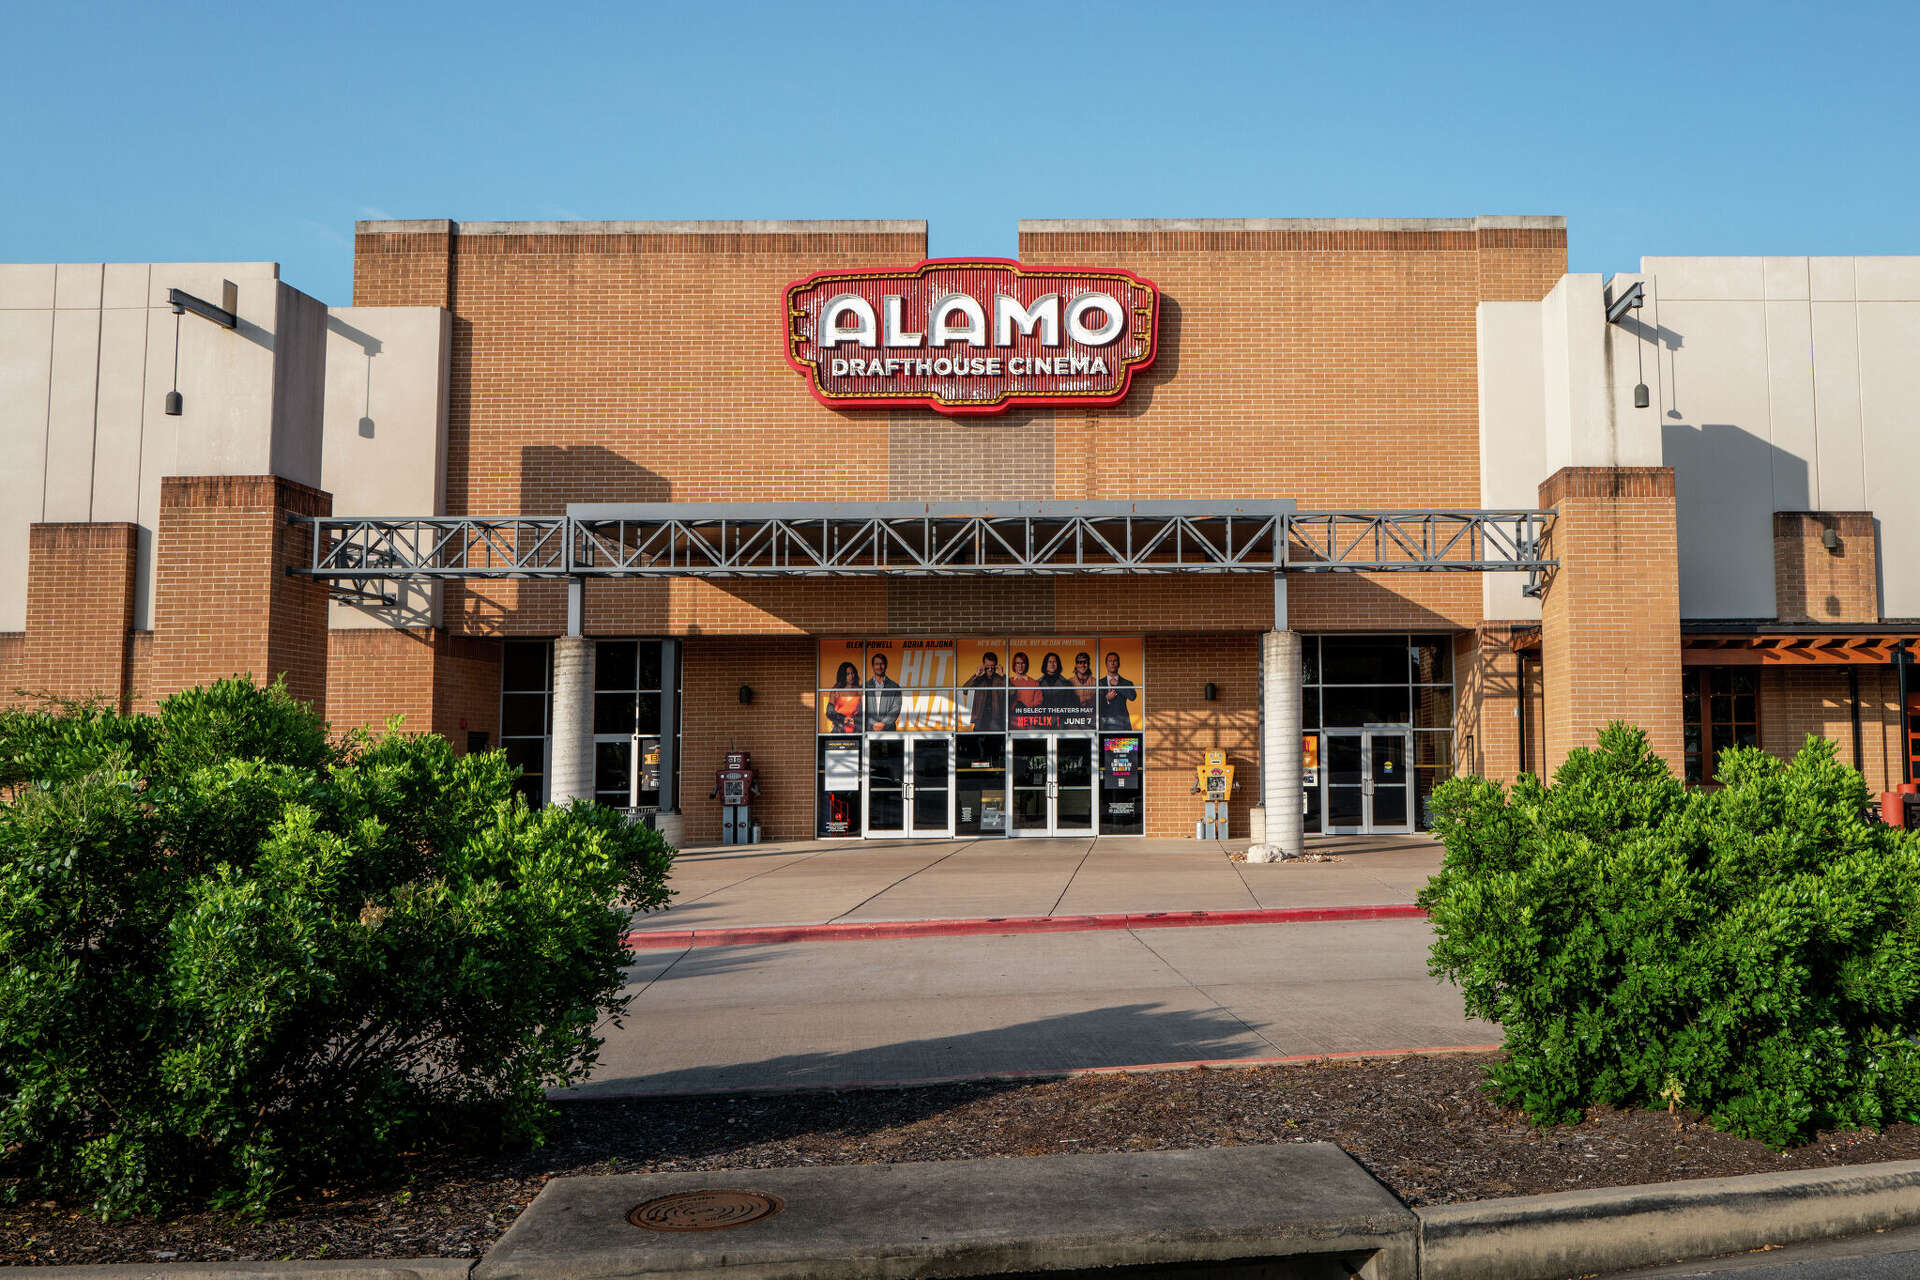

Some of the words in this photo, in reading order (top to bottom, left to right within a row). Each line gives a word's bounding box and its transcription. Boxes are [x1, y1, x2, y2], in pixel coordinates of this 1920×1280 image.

[818, 292, 1124, 348] ALAMO
[831, 356, 1001, 377] DRAFTHOUSE
[1008, 356, 1109, 376] CINEMA
[846, 640, 863, 649] GLEN
[866, 640, 893, 649] POWELL
[902, 640, 923, 649] ADRIA
[925, 640, 953, 649] ARJONA
[899, 650, 953, 687] HIT
[897, 689, 975, 728] MAN
[1017, 716, 1052, 728] NETFLIX
[1064, 717, 1085, 725] JUNE
[1086, 717, 1092, 725] 7
